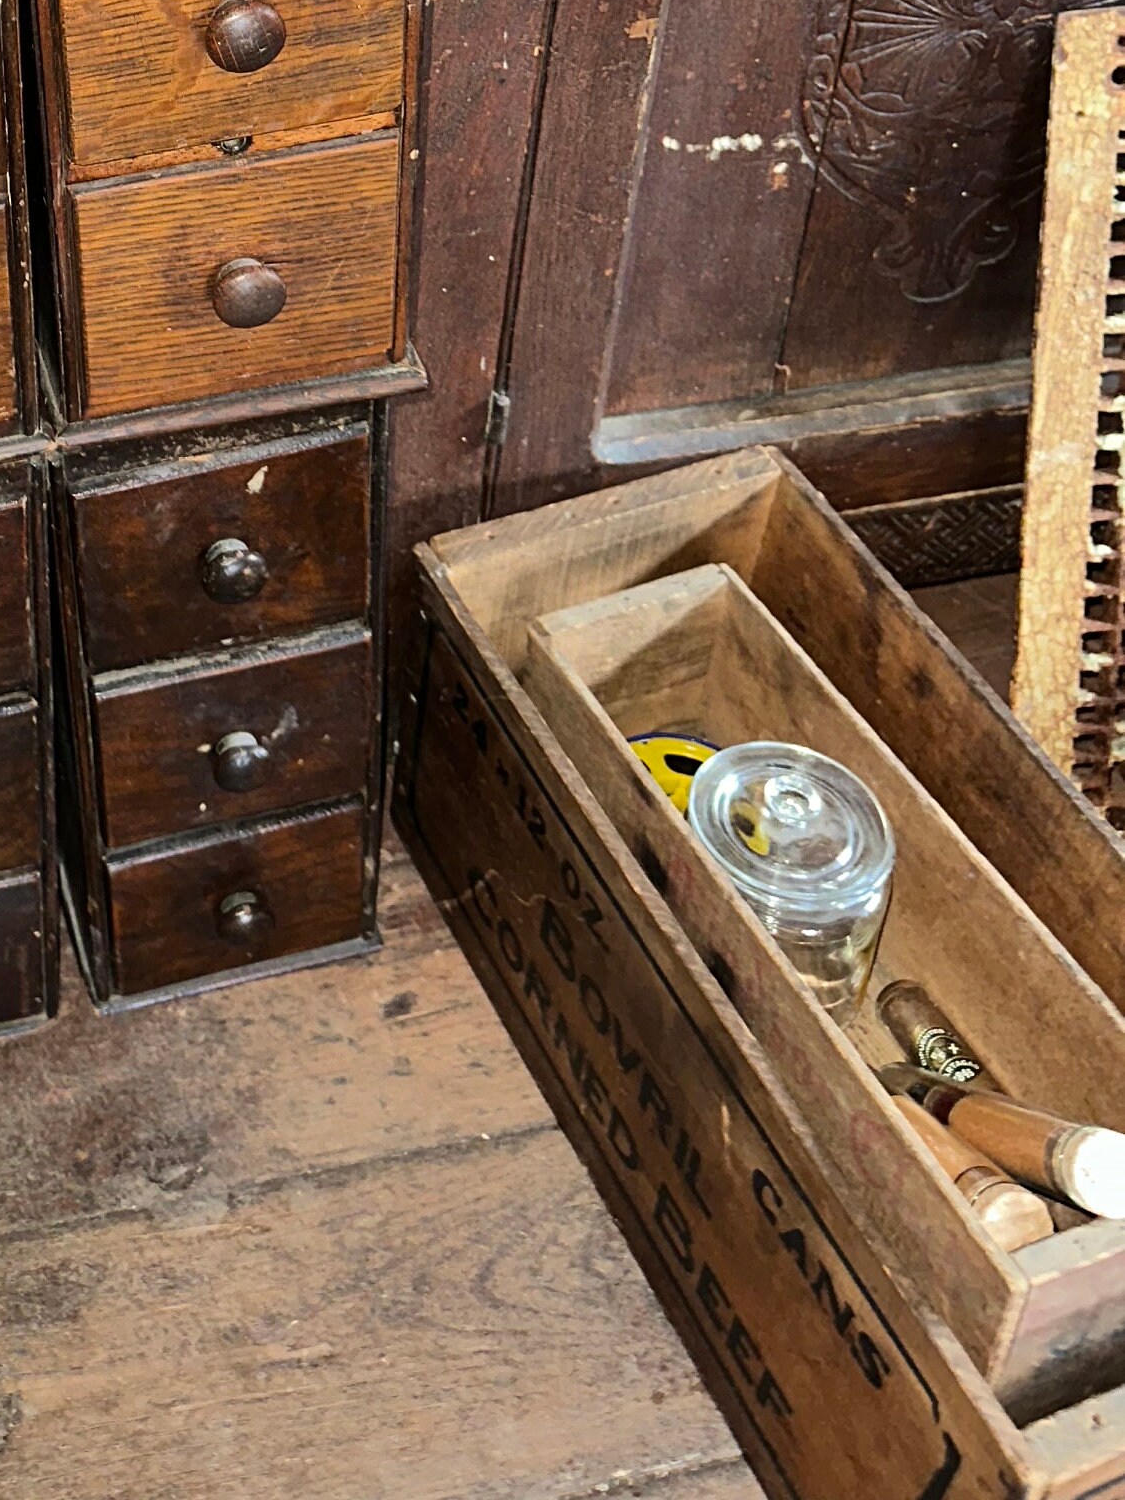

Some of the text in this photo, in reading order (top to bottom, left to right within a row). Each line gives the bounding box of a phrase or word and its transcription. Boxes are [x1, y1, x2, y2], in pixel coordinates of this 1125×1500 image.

[465, 866, 795, 1419] CORNED BEEF
[514, 784, 547, 852] 12
[752, 1168, 892, 1390] CANS
[539, 899, 713, 1222] BOVRIL
